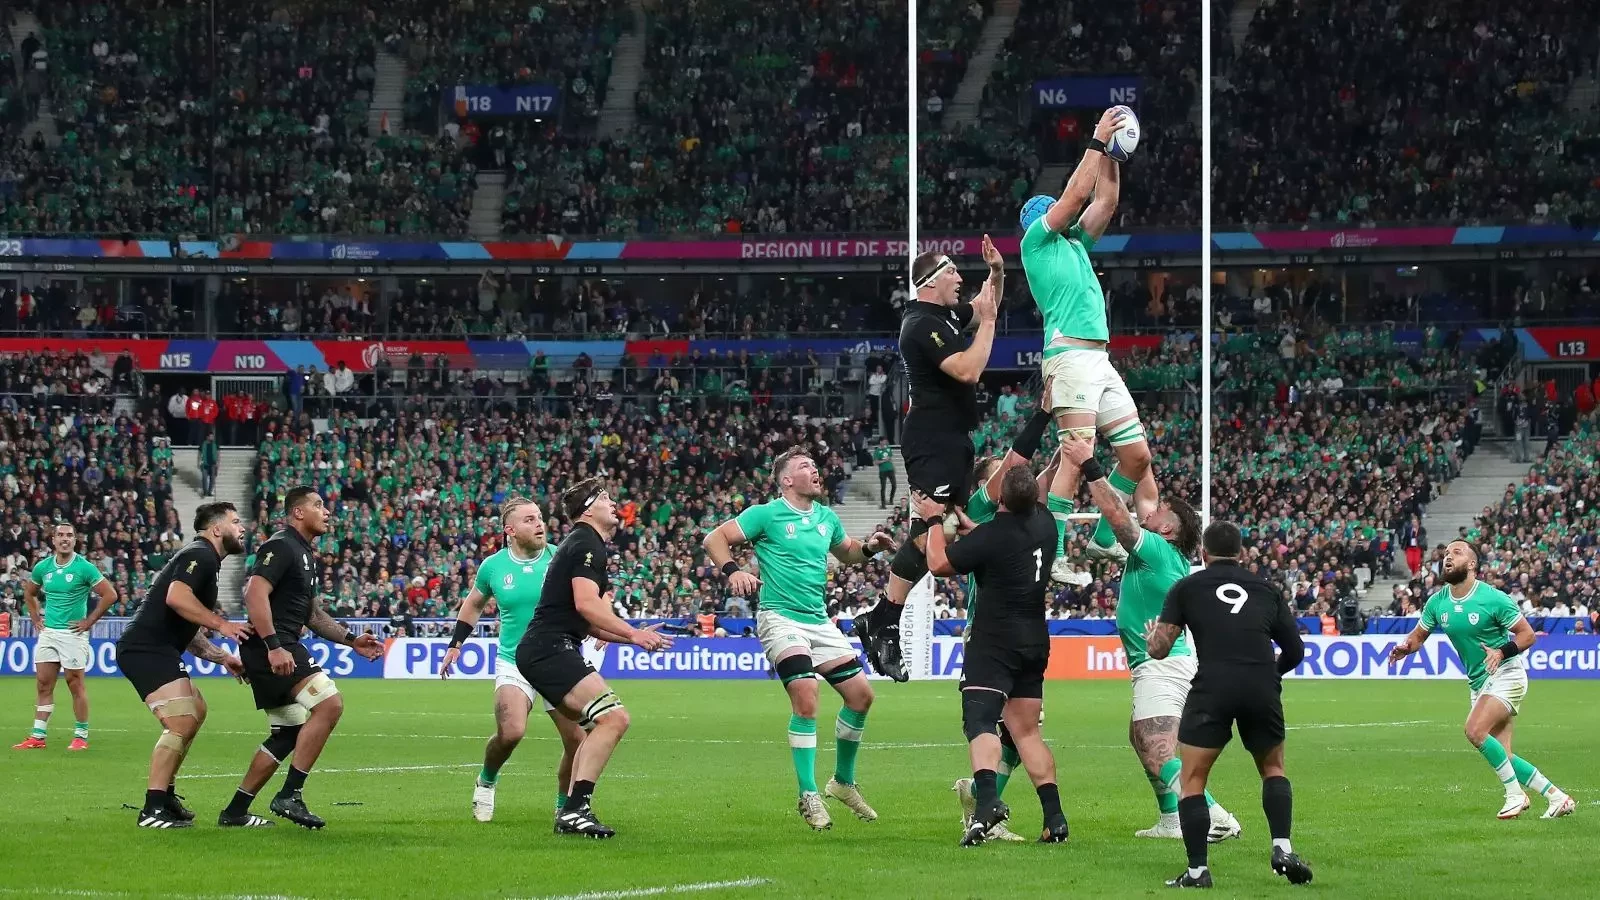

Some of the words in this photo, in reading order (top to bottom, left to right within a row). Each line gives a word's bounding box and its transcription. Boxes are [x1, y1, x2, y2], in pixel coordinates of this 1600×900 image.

[1040, 88, 1068, 105] N6
[1109, 87, 1137, 103] N5
[516, 95, 553, 112] N17
[1559, 341, 1585, 356] L13
[160, 353, 191, 368] N15
[234, 355, 265, 369] N10
[1016, 351, 1042, 366] L14
[1032, 547, 1043, 582] 1
[1215, 583, 1249, 614] 9
[1272, 641, 1468, 676] ROMAN
